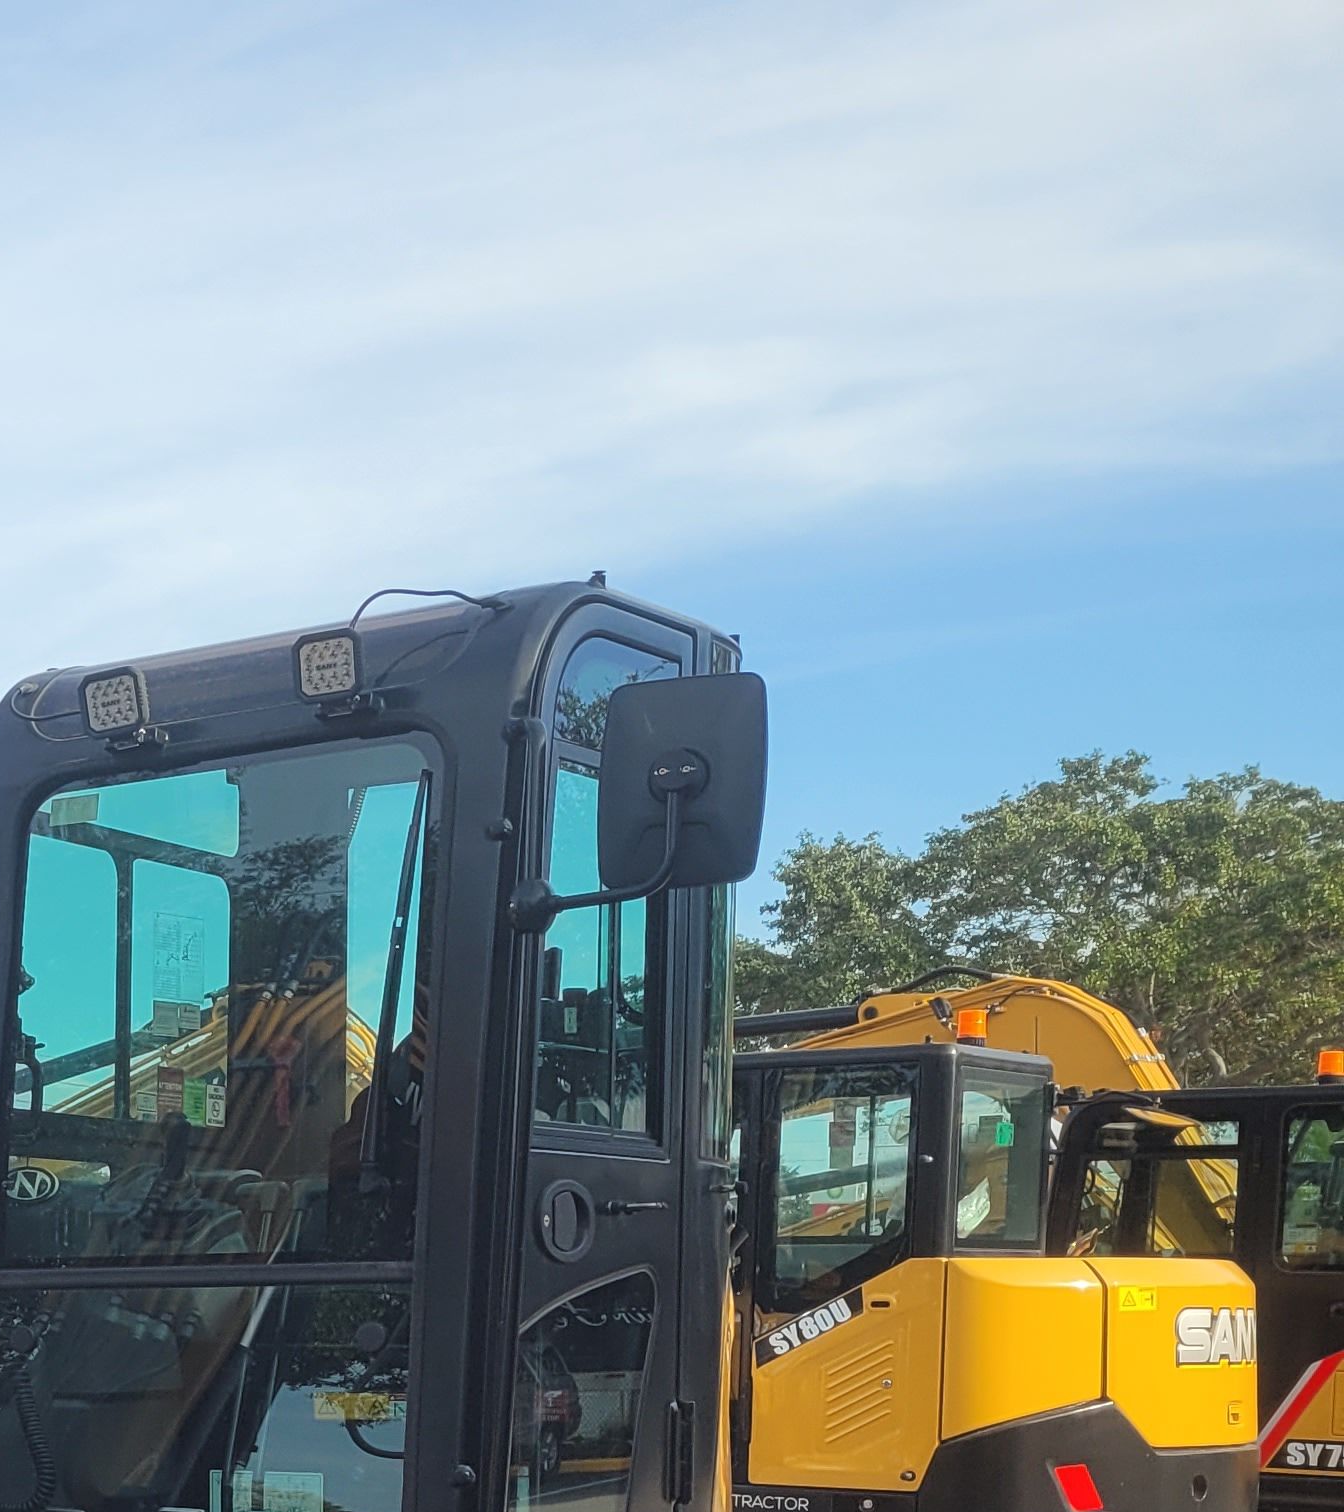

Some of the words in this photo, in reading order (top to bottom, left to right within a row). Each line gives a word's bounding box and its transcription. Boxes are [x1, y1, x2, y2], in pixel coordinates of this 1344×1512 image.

[768, 1298, 852, 1356] SY80U
[1175, 1307, 1256, 1367] SAN
[1286, 1442, 1344, 1468] SY7
